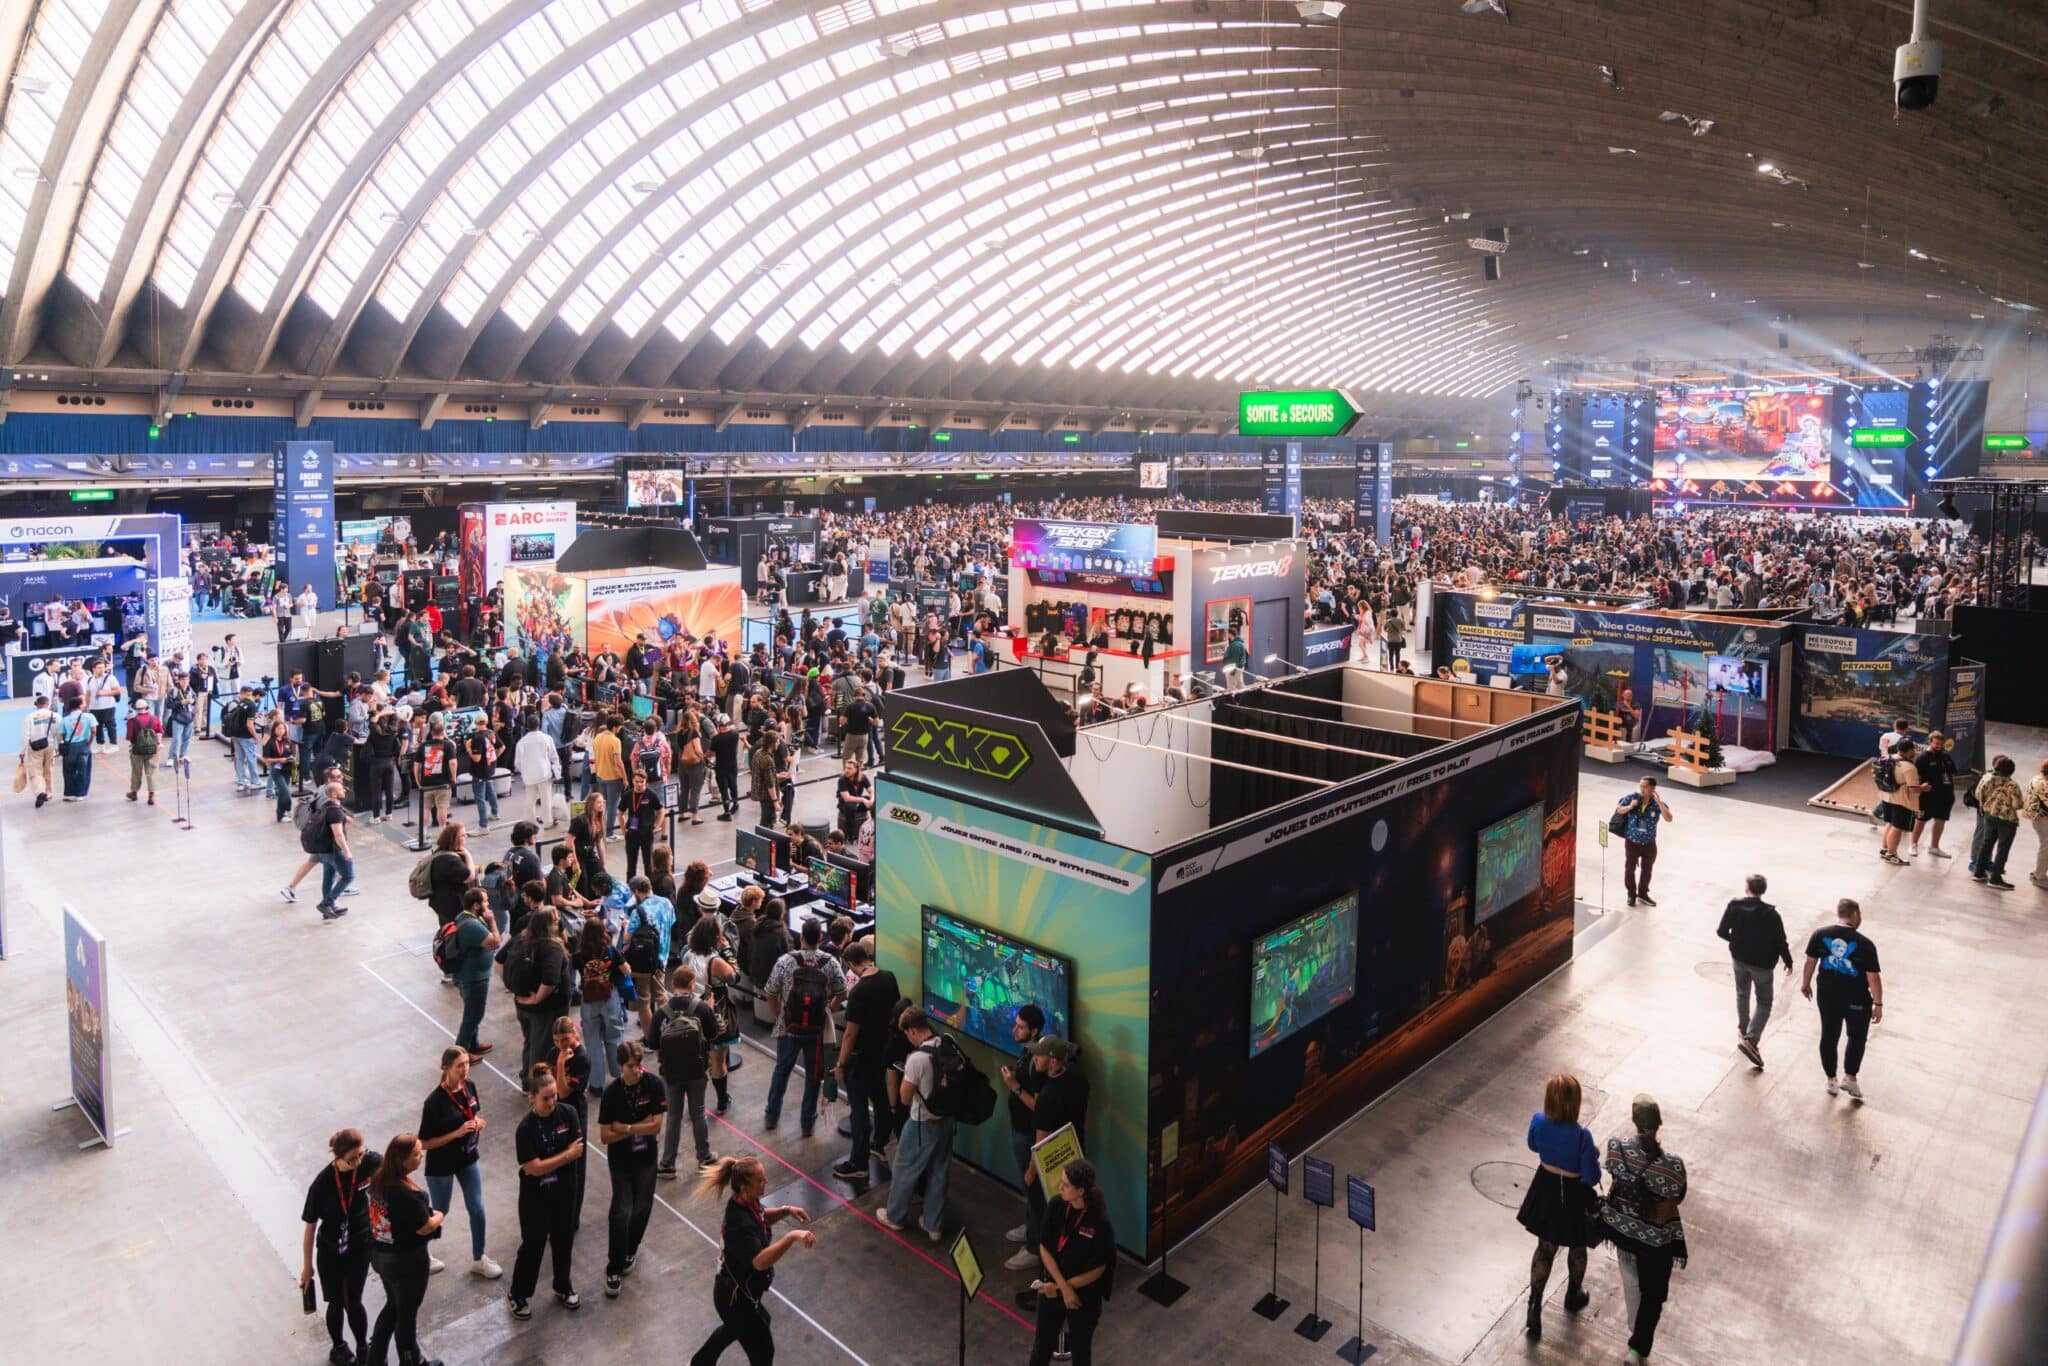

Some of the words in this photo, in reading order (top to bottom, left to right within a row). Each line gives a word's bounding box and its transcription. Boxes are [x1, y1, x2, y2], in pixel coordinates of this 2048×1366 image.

[1247, 405, 1279, 422] SORTIE
[1289, 404, 1334, 422] SECOURS
[509, 512, 544, 525] ARC
[26, 526, 73, 536] nacon
[1046, 525, 1117, 539] TEKKEN
[1055, 537, 1107, 548] SHOP
[1208, 560, 1281, 584] TEKKEN
[1275, 555, 1293, 578] 8
[148, 602, 156, 627] nacon
[1592, 630, 1622, 638] terrain
[1636, 634, 1651, 642] jeu
[1653, 635, 1673, 643] 365
[1674, 637, 1714, 648] jours/an
[1599, 622, 1624, 630] Nice
[1626, 623, 1653, 633] Côte
[1655, 626, 1694, 639] d'Azur,
[1305, 640, 1344, 656] TEKKEN
[1460, 642, 1502, 652] TEKKEN
[1510, 736, 1526, 748] EVO
[1526, 724, 1555, 742] FRANCE
[891, 712, 1031, 780] 2XKO
[1264, 820, 1308, 844] JOUEZ
[1309, 785, 1396, 827] GRATUITEMENT
[1406, 770, 1432, 788] FREE
[1432, 765, 1446, 778] TO
[1446, 757, 1471, 774] PLAY
[940, 825, 969, 839] JOUEZ
[969, 833, 997, 847] ENTRE
[999, 842, 1023, 855] AMIS
[1032, 852, 1057, 866] PLAY
[1058, 860, 1084, 874] WITH
[1085, 867, 1130, 888] FRIENDS
